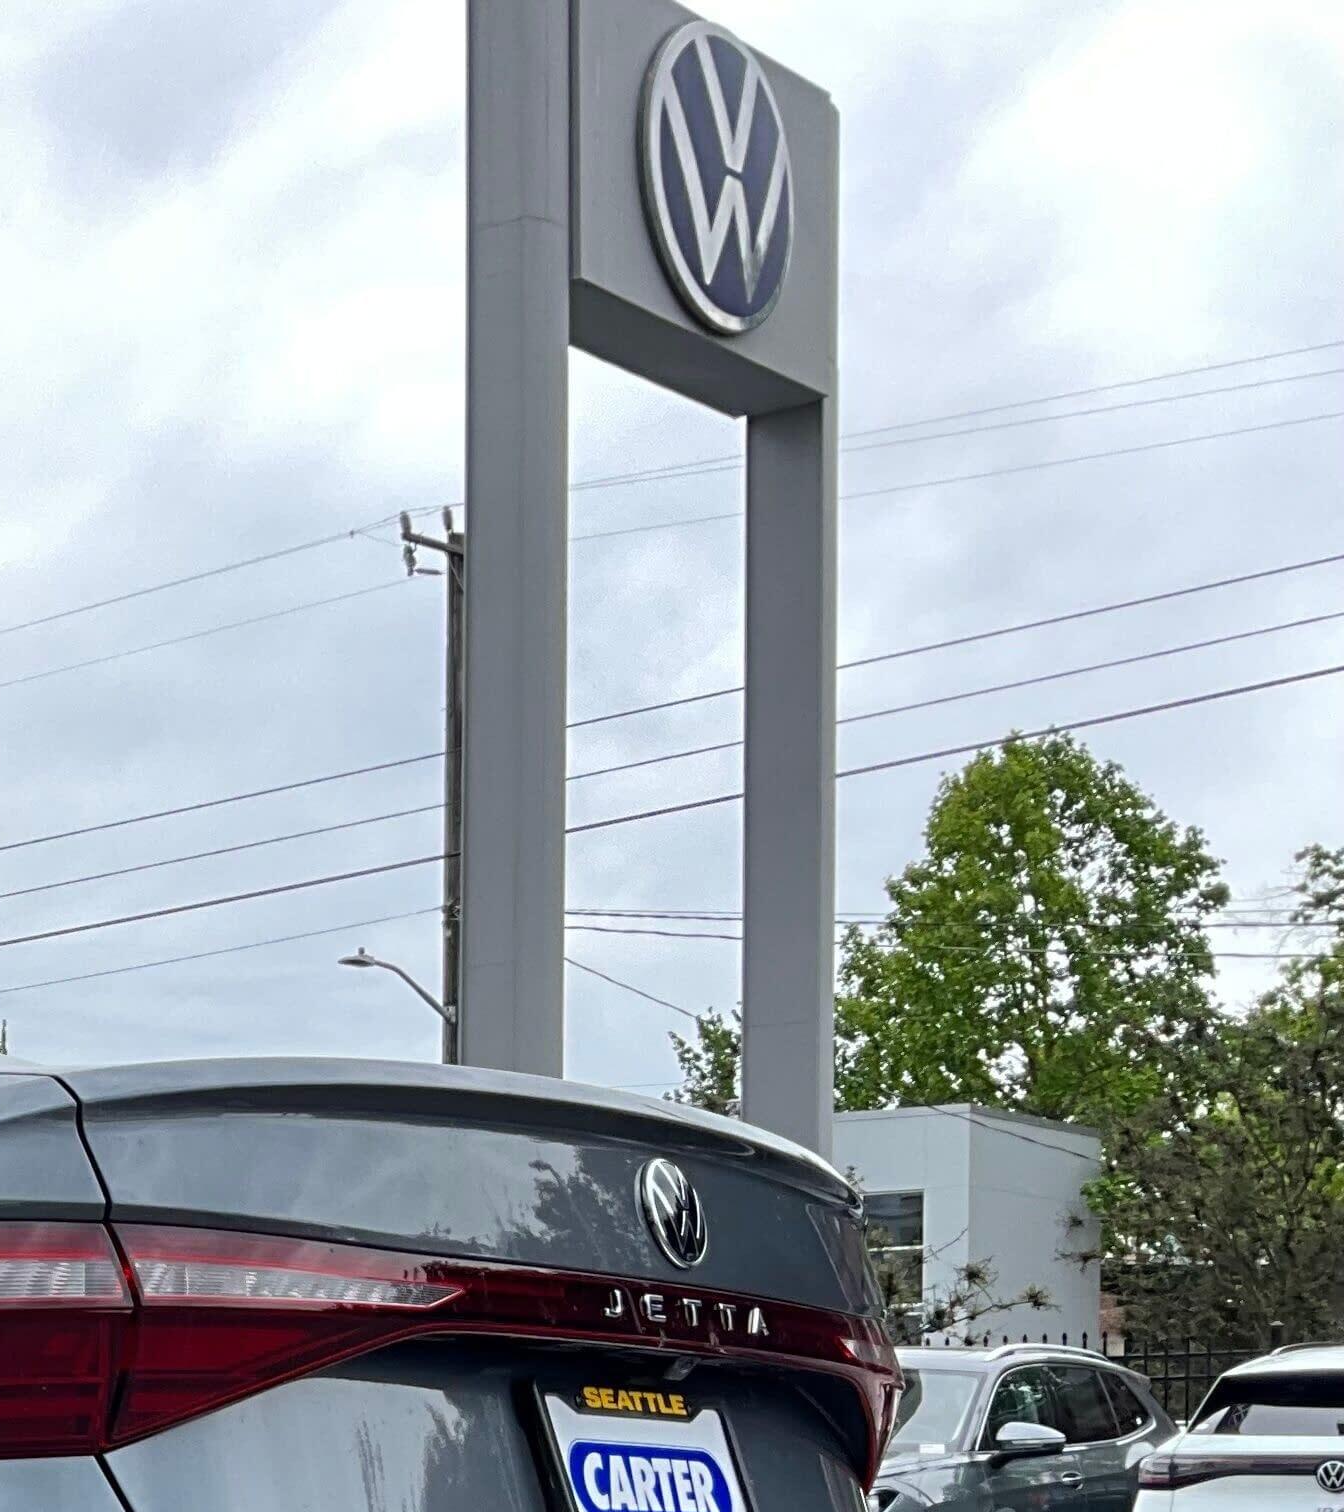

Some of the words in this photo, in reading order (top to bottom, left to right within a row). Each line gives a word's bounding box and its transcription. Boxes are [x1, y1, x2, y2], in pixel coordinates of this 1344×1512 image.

[646, 22, 794, 328] VW
[603, 1289, 769, 1336] JETTA
[582, 1386, 688, 1416] SEATTLE
